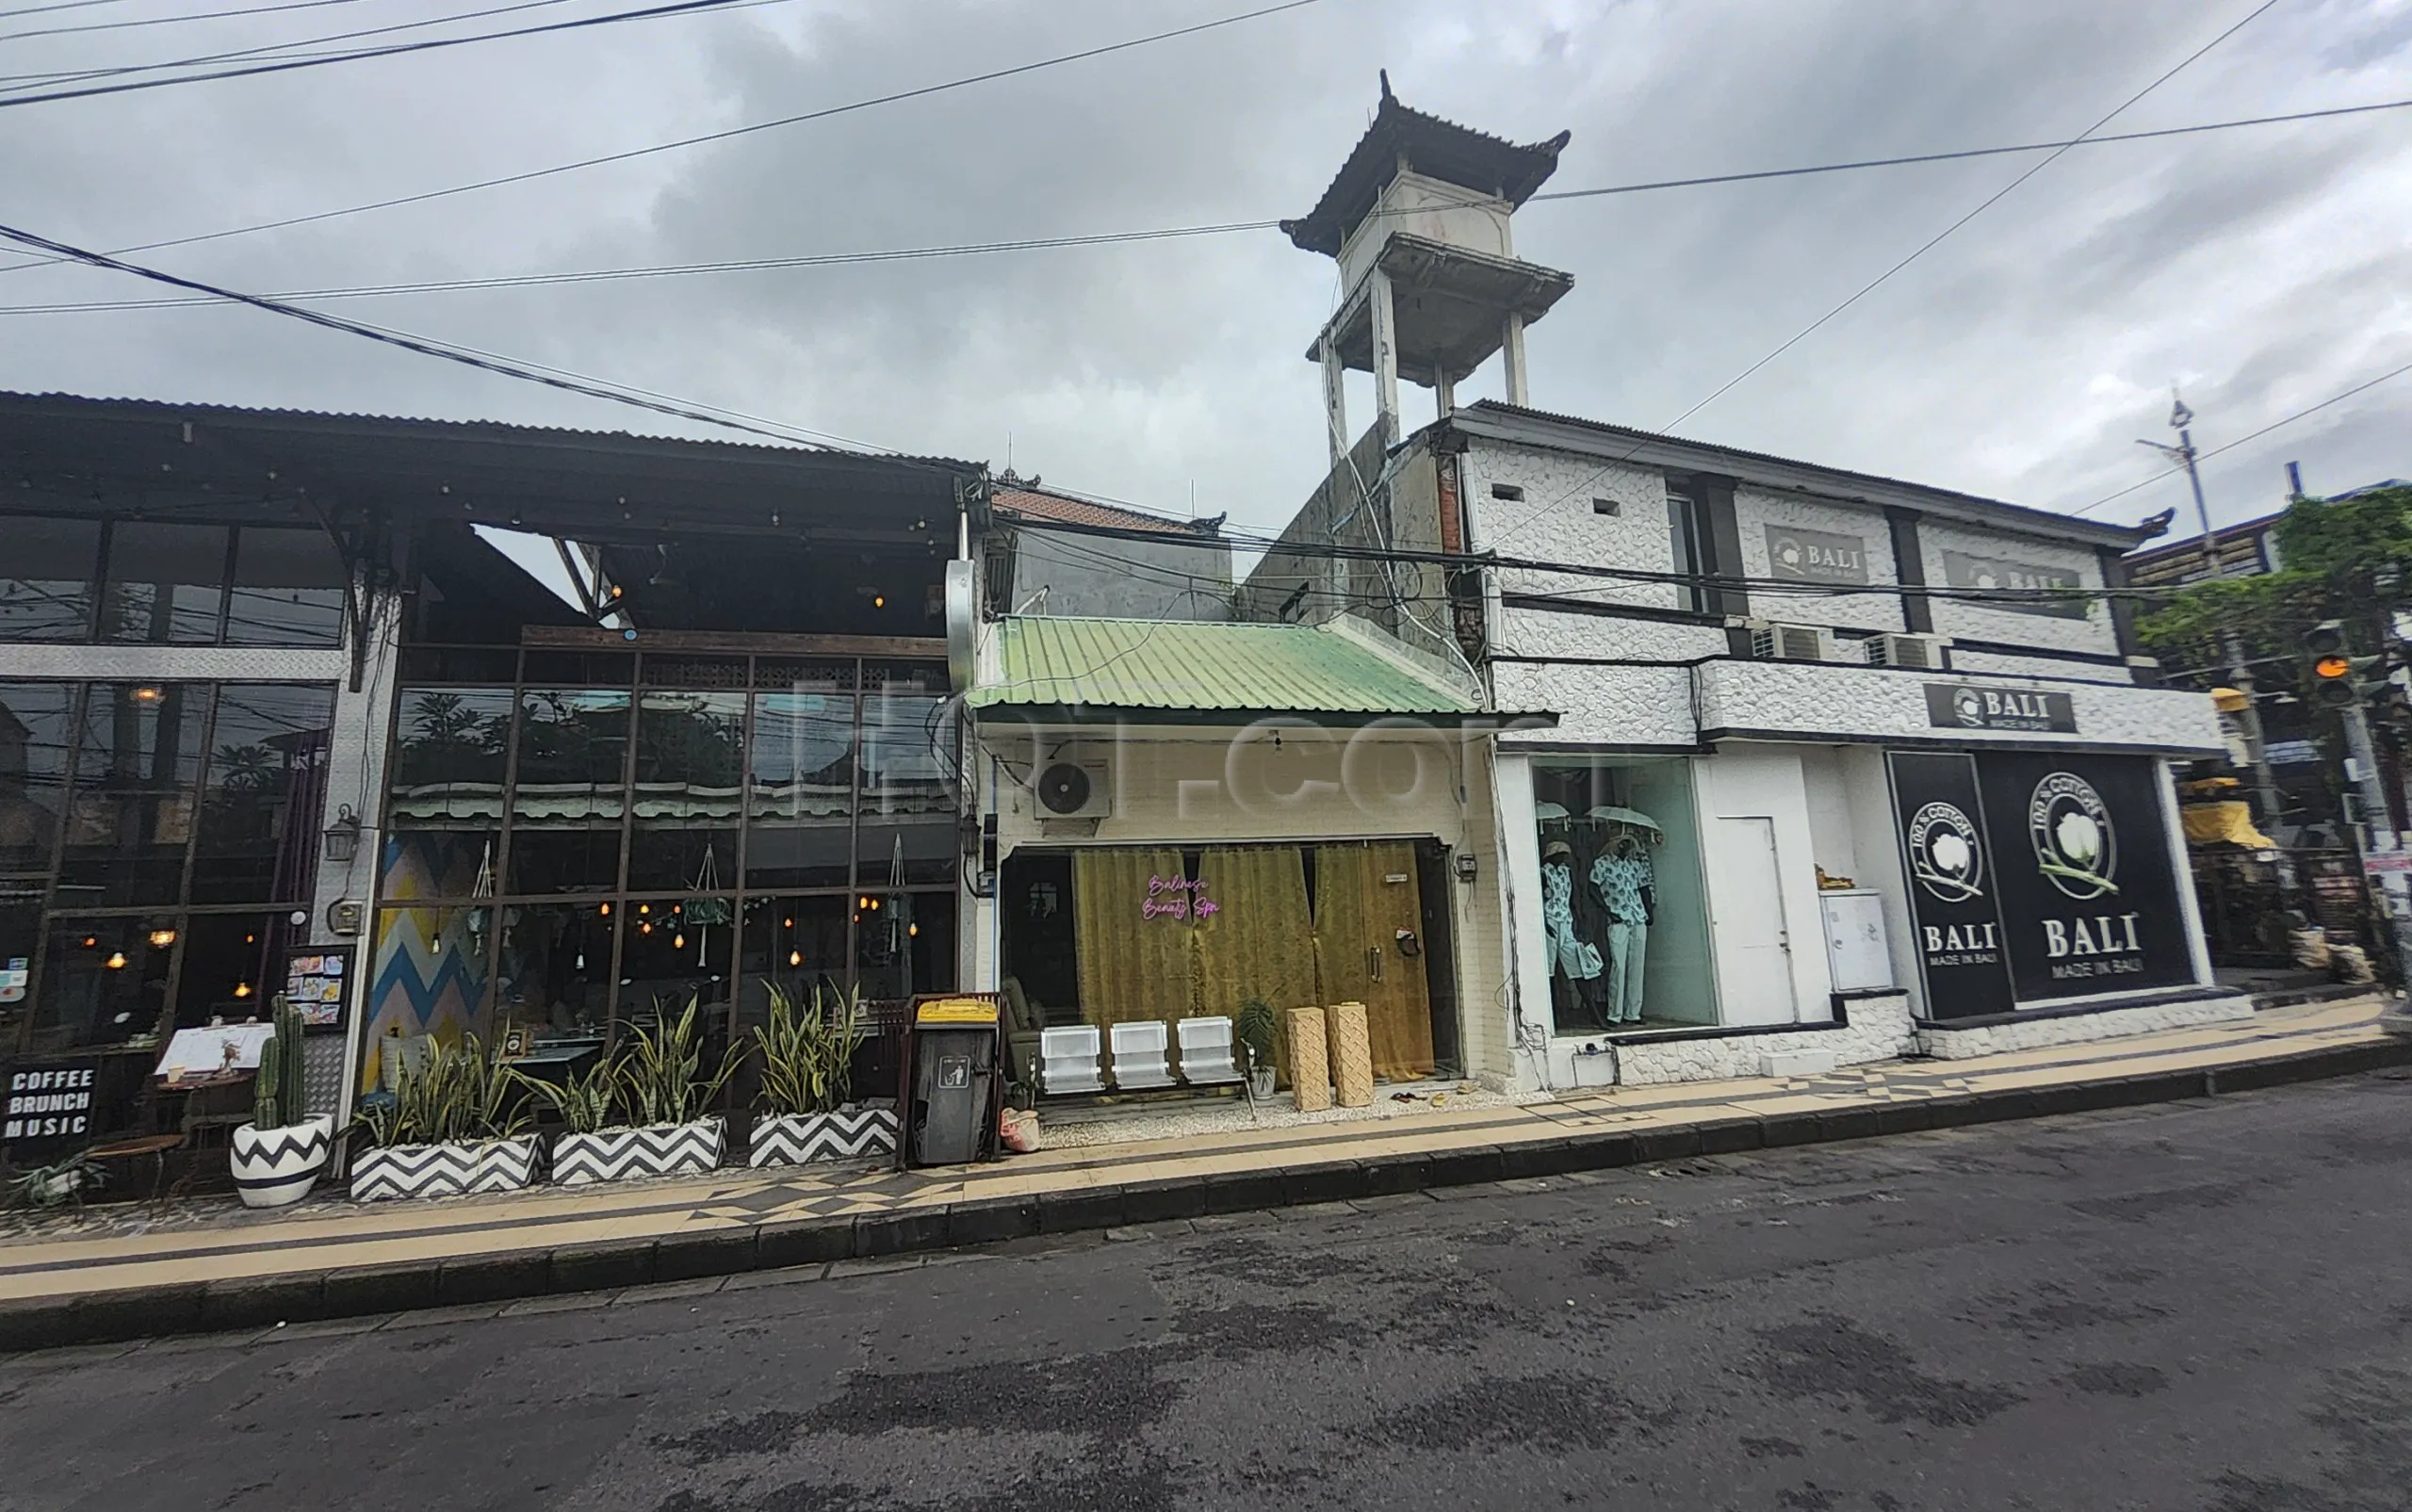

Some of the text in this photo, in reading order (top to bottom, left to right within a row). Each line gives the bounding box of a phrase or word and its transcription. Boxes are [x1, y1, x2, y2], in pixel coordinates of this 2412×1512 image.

[1806, 545, 1861, 569] BALI
[1982, 691, 2051, 718] BALI
[1149, 874, 1209, 896] Balinese
[1142, 897, 1220, 919] Beauty Spa
[1922, 923, 1998, 952] BALI
[2041, 914, 2143, 958] BALI
[11, 1069, 94, 1091] COFFEE
[8, 1092, 90, 1114] BRUNCH
[4, 1115, 88, 1139] MUSIC
